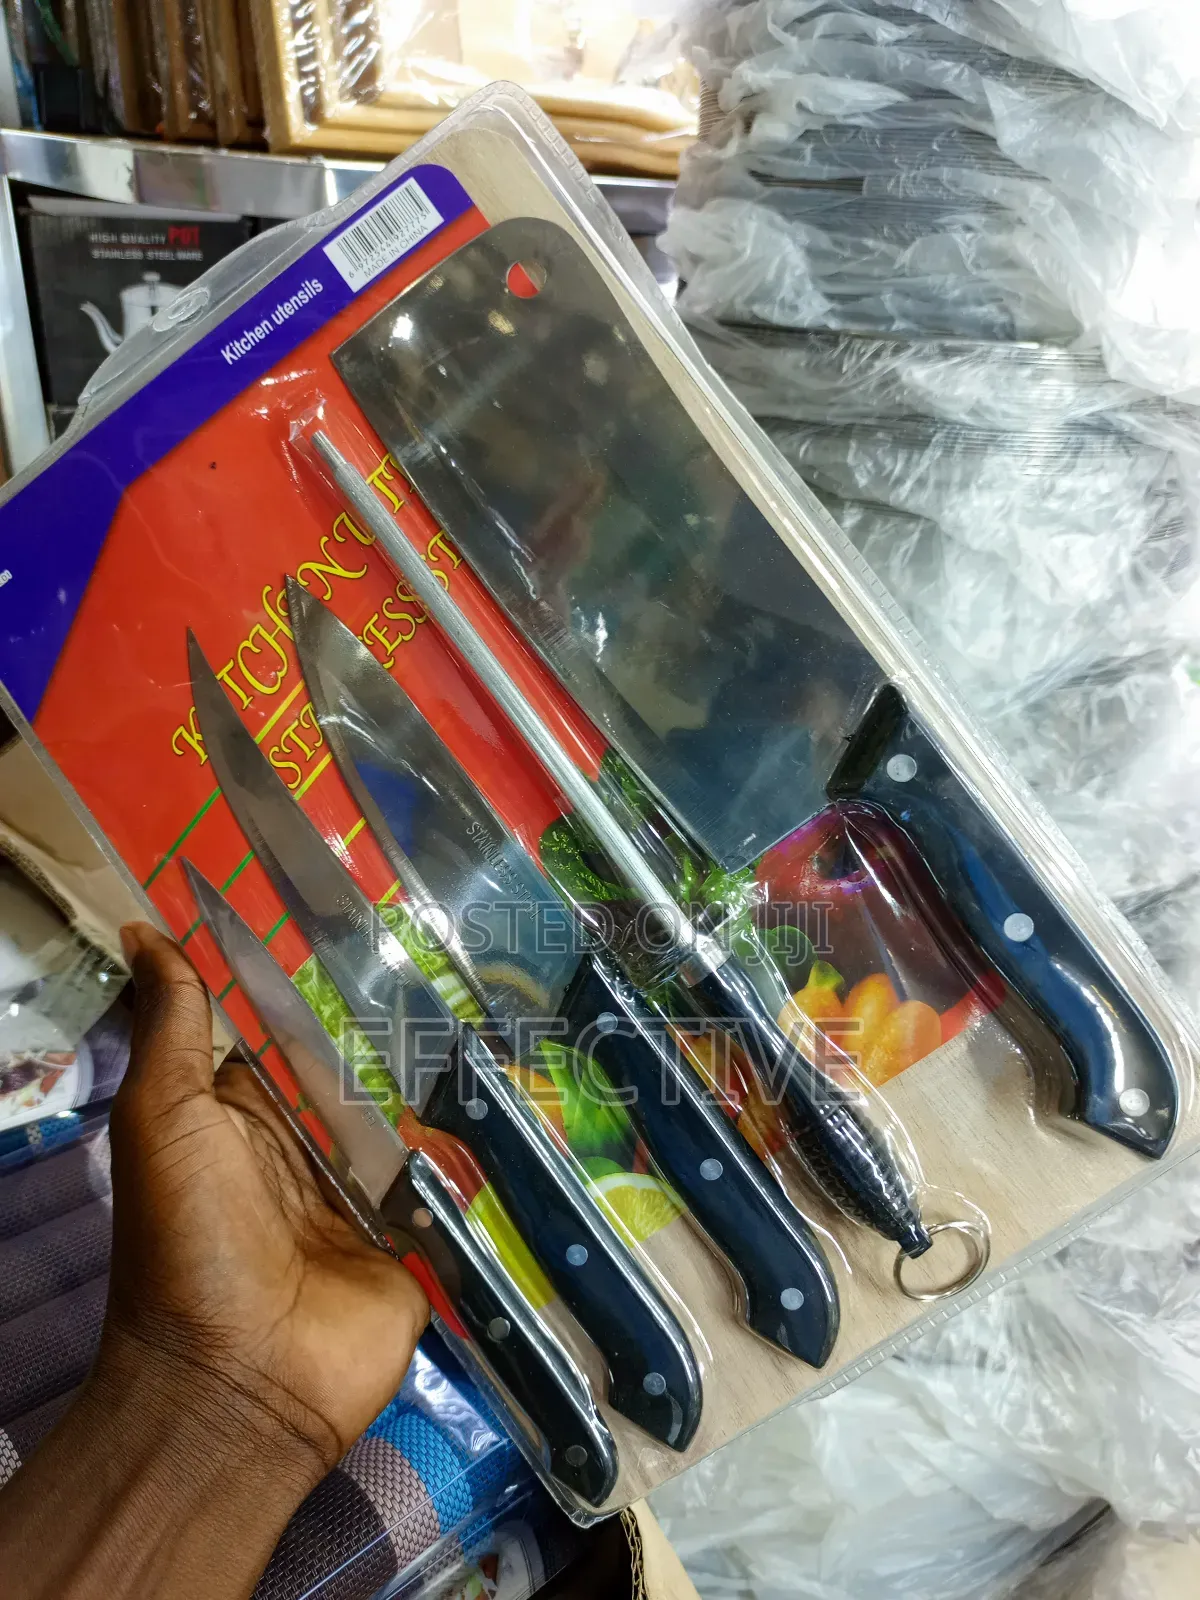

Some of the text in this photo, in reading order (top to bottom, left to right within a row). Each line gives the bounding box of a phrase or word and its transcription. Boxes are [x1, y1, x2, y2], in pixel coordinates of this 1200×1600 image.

[89, 224, 200, 247] HIGH QUALITY POT
[91, 247, 144, 260] STAINLESS
[363, 225, 429, 278] MADE IN CHINA
[220, 278, 324, 366] Kitchen utensils
[171, 535, 368, 765] KTCHN
[466, 821, 518, 888] STAINLESS
